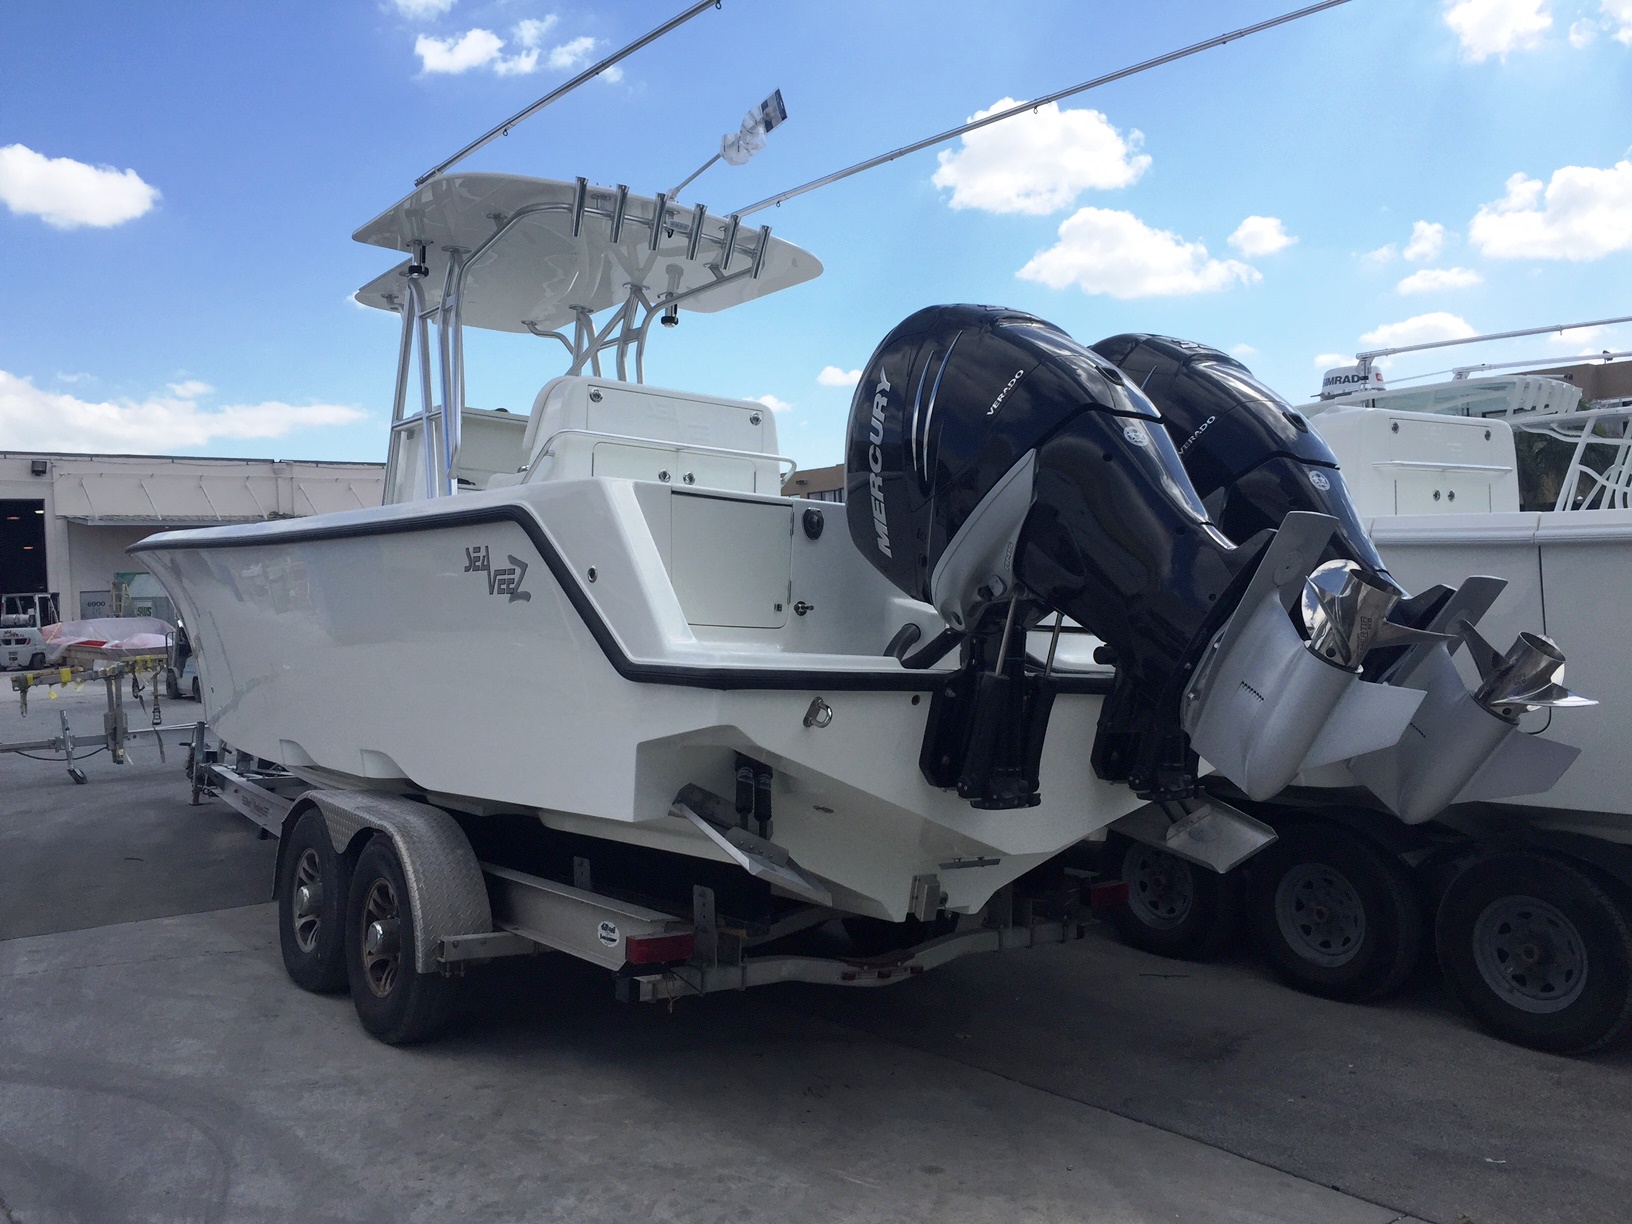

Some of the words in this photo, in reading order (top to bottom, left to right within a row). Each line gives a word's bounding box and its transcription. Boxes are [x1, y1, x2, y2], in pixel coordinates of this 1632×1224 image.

[986, 369, 1025, 415] VERADO
[1178, 415, 1216, 455] VERADO
[868, 366, 892, 559] MERCURY
